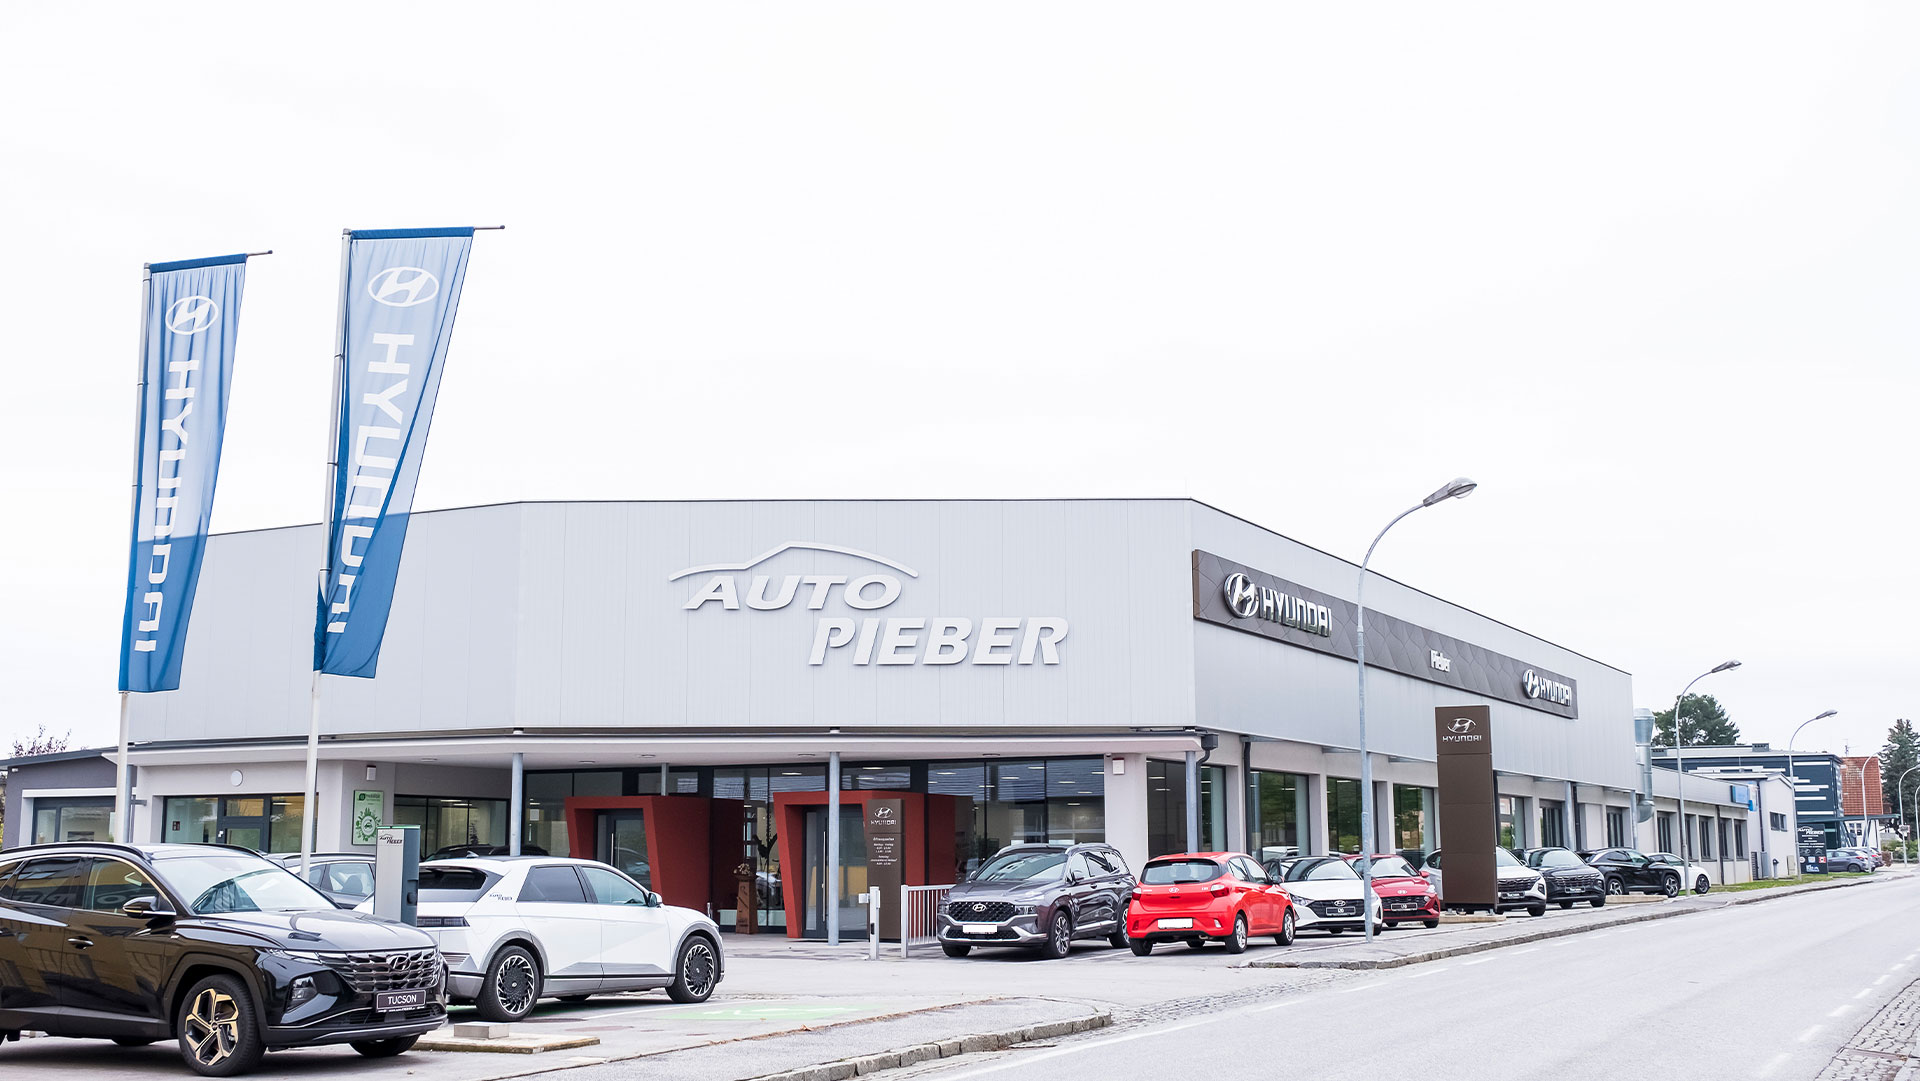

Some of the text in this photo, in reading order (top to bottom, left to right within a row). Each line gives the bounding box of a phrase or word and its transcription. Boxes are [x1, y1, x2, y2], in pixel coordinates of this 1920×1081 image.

[327, 332, 415, 633] HYUNDAI
[134, 359, 200, 652] HYUNDAI
[682, 574, 902, 610] AUTO
[1260, 586, 1332, 637] HYUNDAI
[808, 617, 1069, 666] PIEBER
[1539, 676, 1572, 707] HYUNDAI
[1442, 734, 1482, 742] HYUNDAI
[387, 994, 417, 1005] TUCSON
